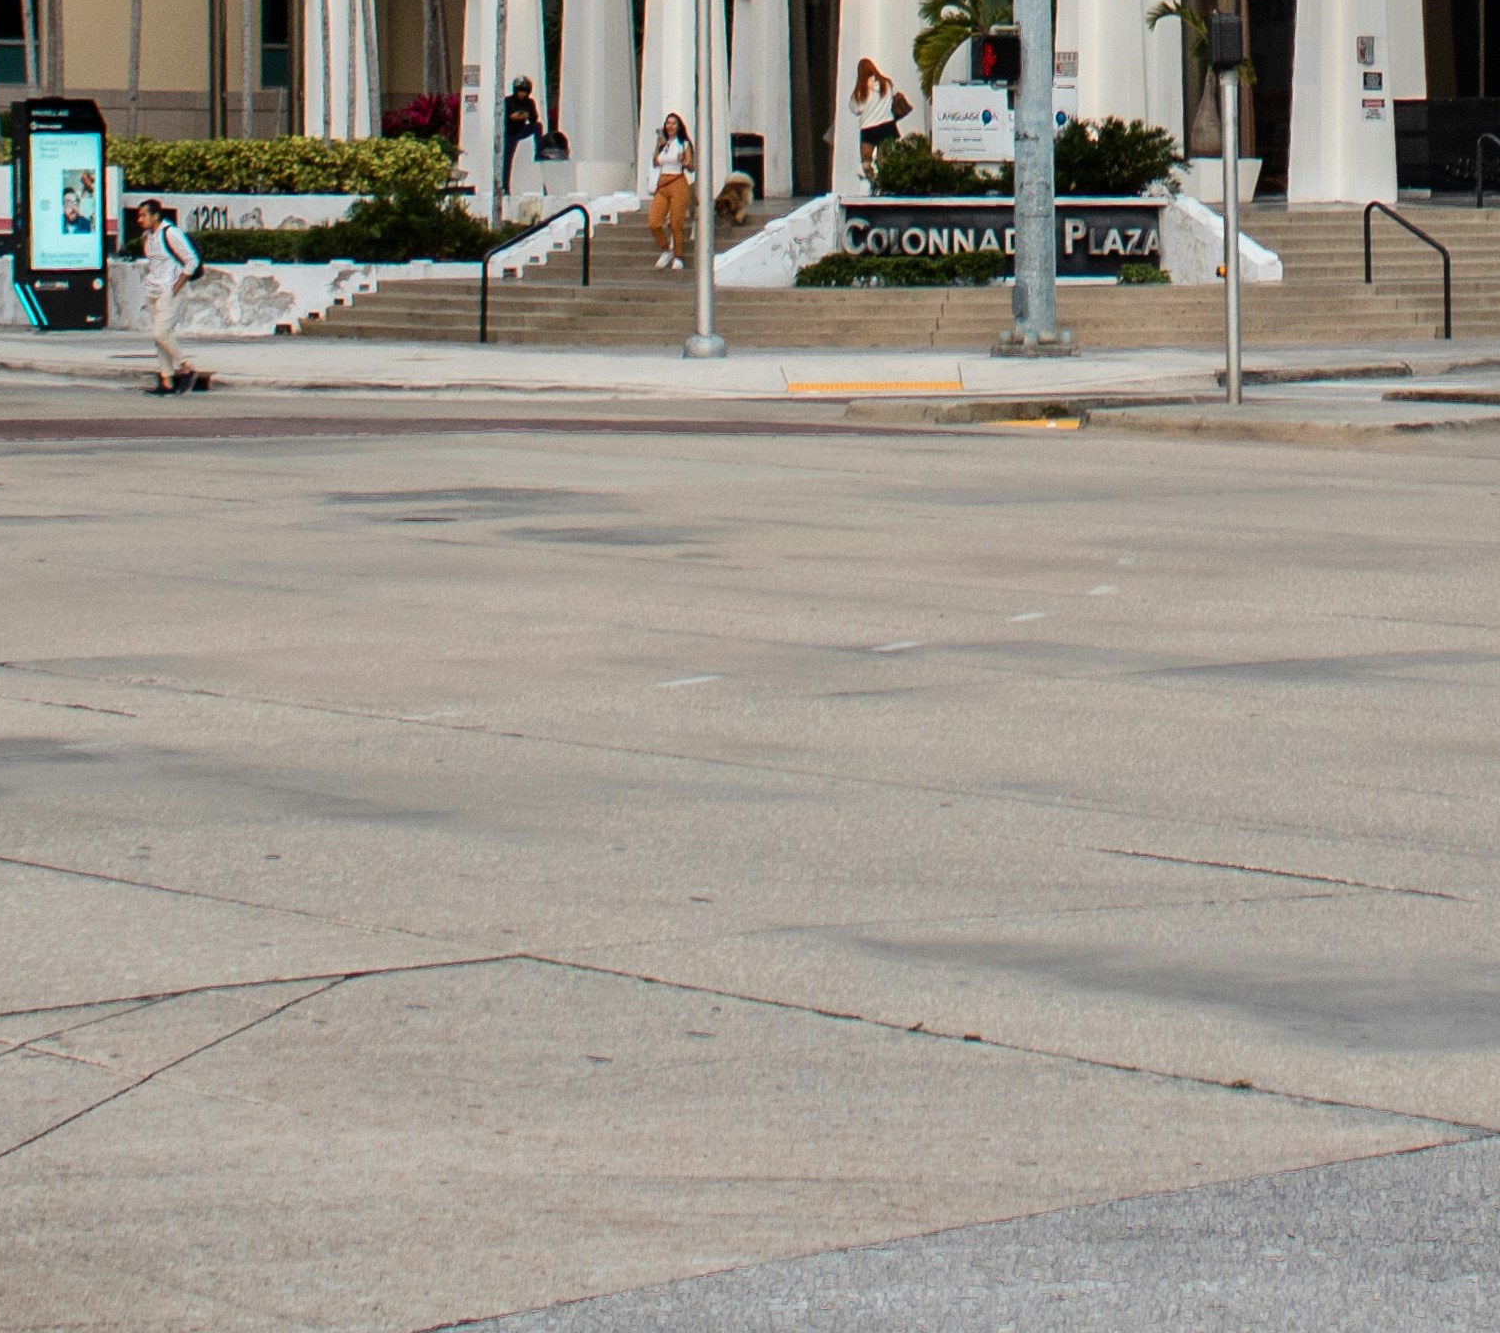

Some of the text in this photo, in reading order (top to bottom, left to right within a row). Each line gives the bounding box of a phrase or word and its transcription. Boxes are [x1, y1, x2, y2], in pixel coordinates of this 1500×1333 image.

[193, 205, 228, 230] 1201
[841, 217, 1162, 256] COLONNAD PLAZA
